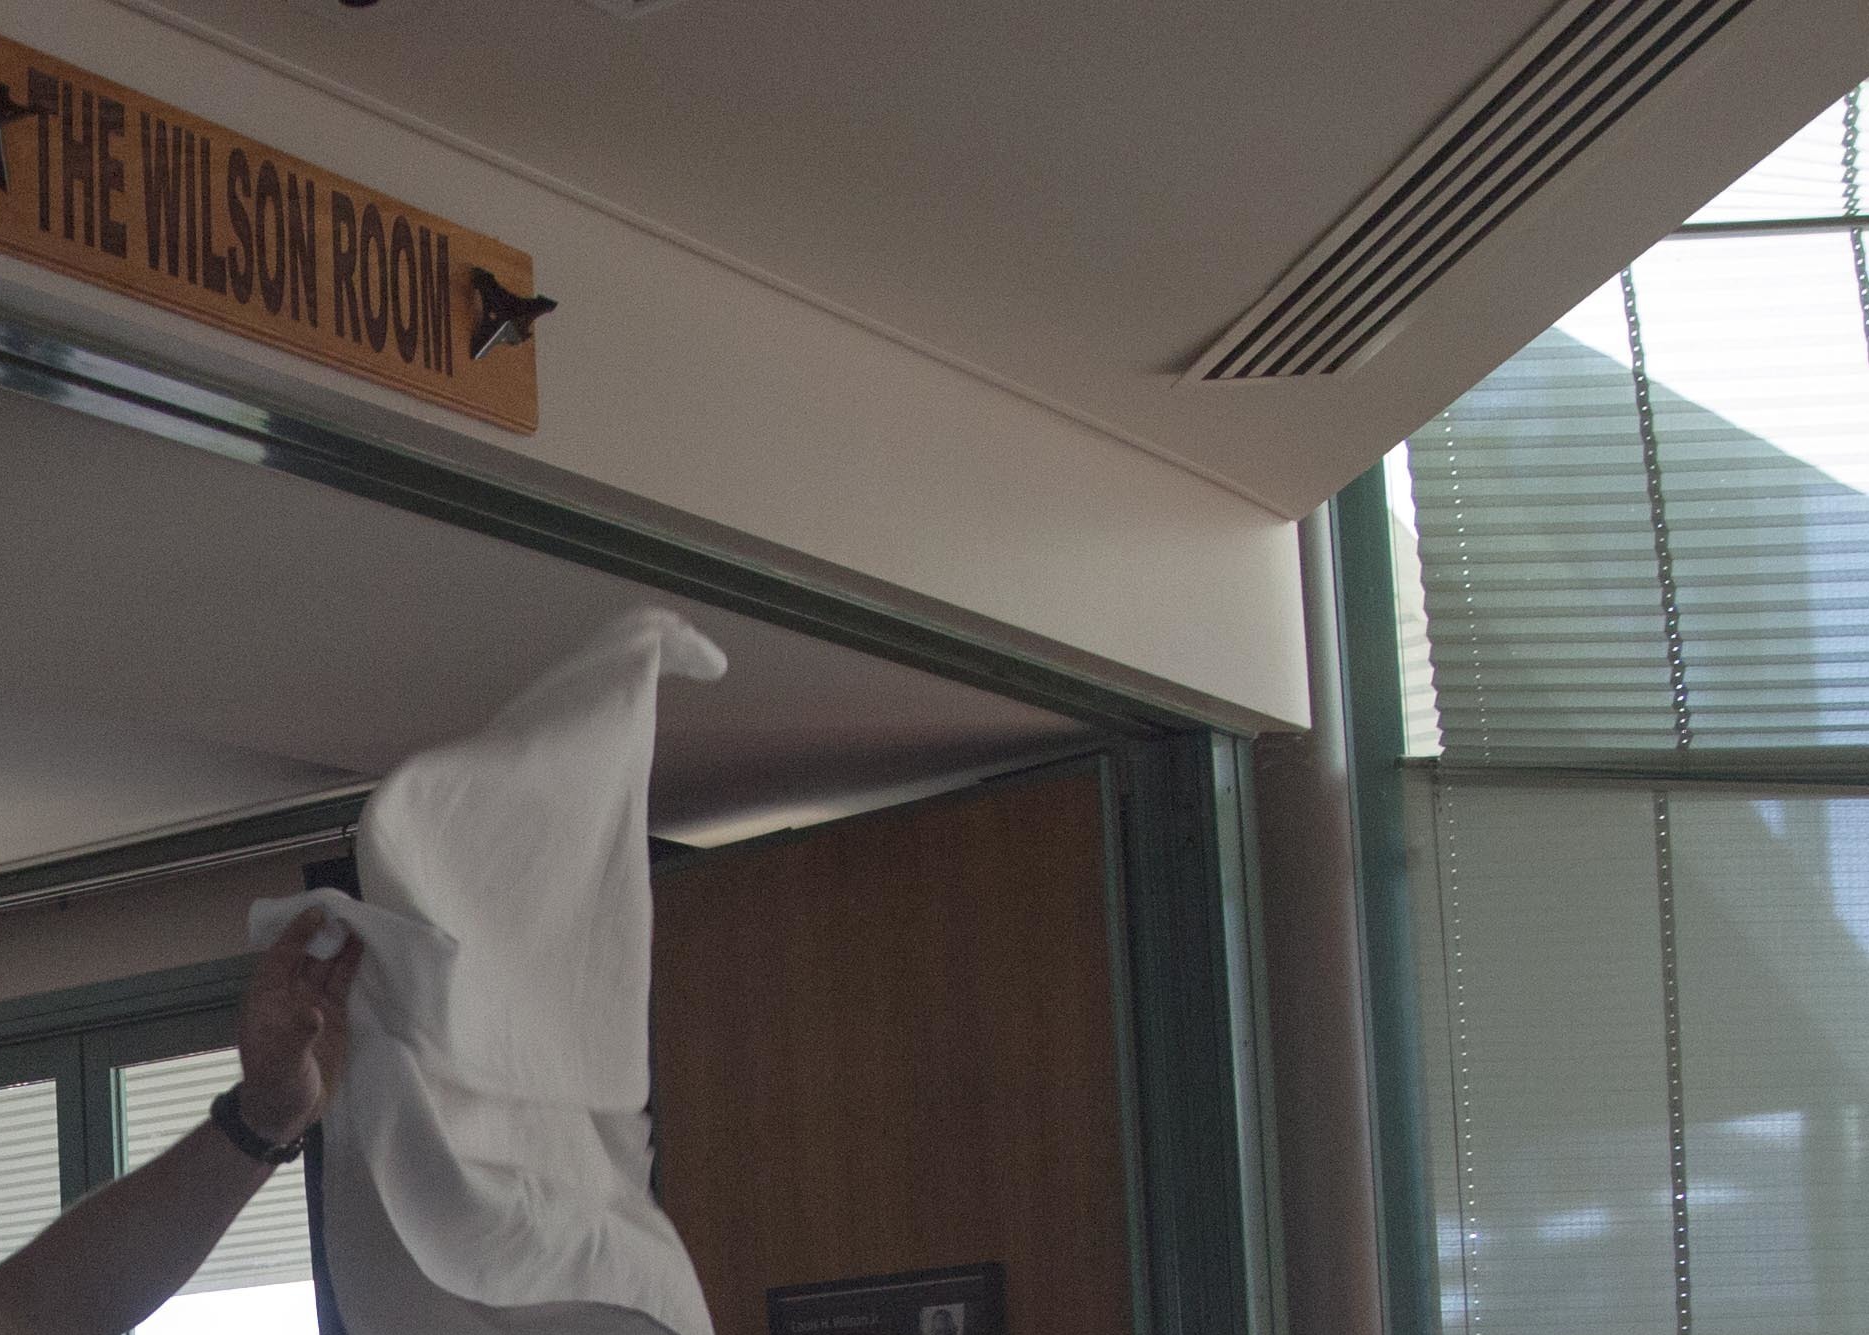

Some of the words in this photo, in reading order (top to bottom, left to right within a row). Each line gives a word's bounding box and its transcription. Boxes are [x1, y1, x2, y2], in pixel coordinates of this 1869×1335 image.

[28, 67, 127, 258] THE
[141, 112, 319, 327] WILSON
[332, 191, 453, 377] ROOM
